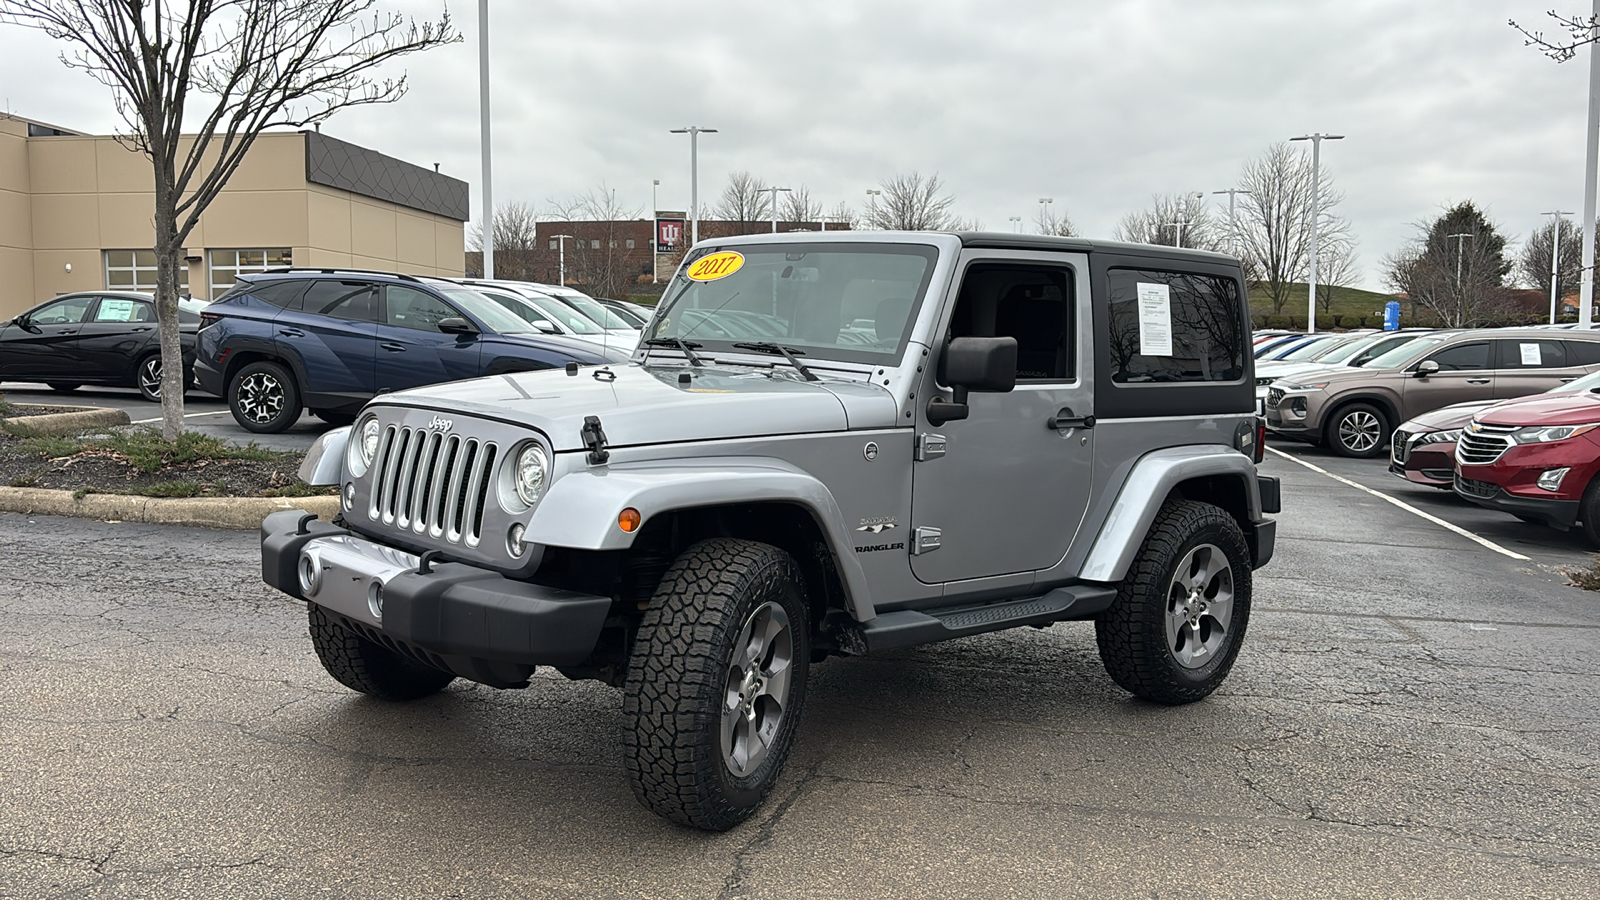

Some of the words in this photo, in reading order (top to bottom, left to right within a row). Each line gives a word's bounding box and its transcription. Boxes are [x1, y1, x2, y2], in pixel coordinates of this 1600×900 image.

[692, 256, 738, 277] 2017
[428, 415, 453, 434] Jeep
[860, 516, 898, 525] SAHARA
[854, 542, 905, 553] RANGLER
